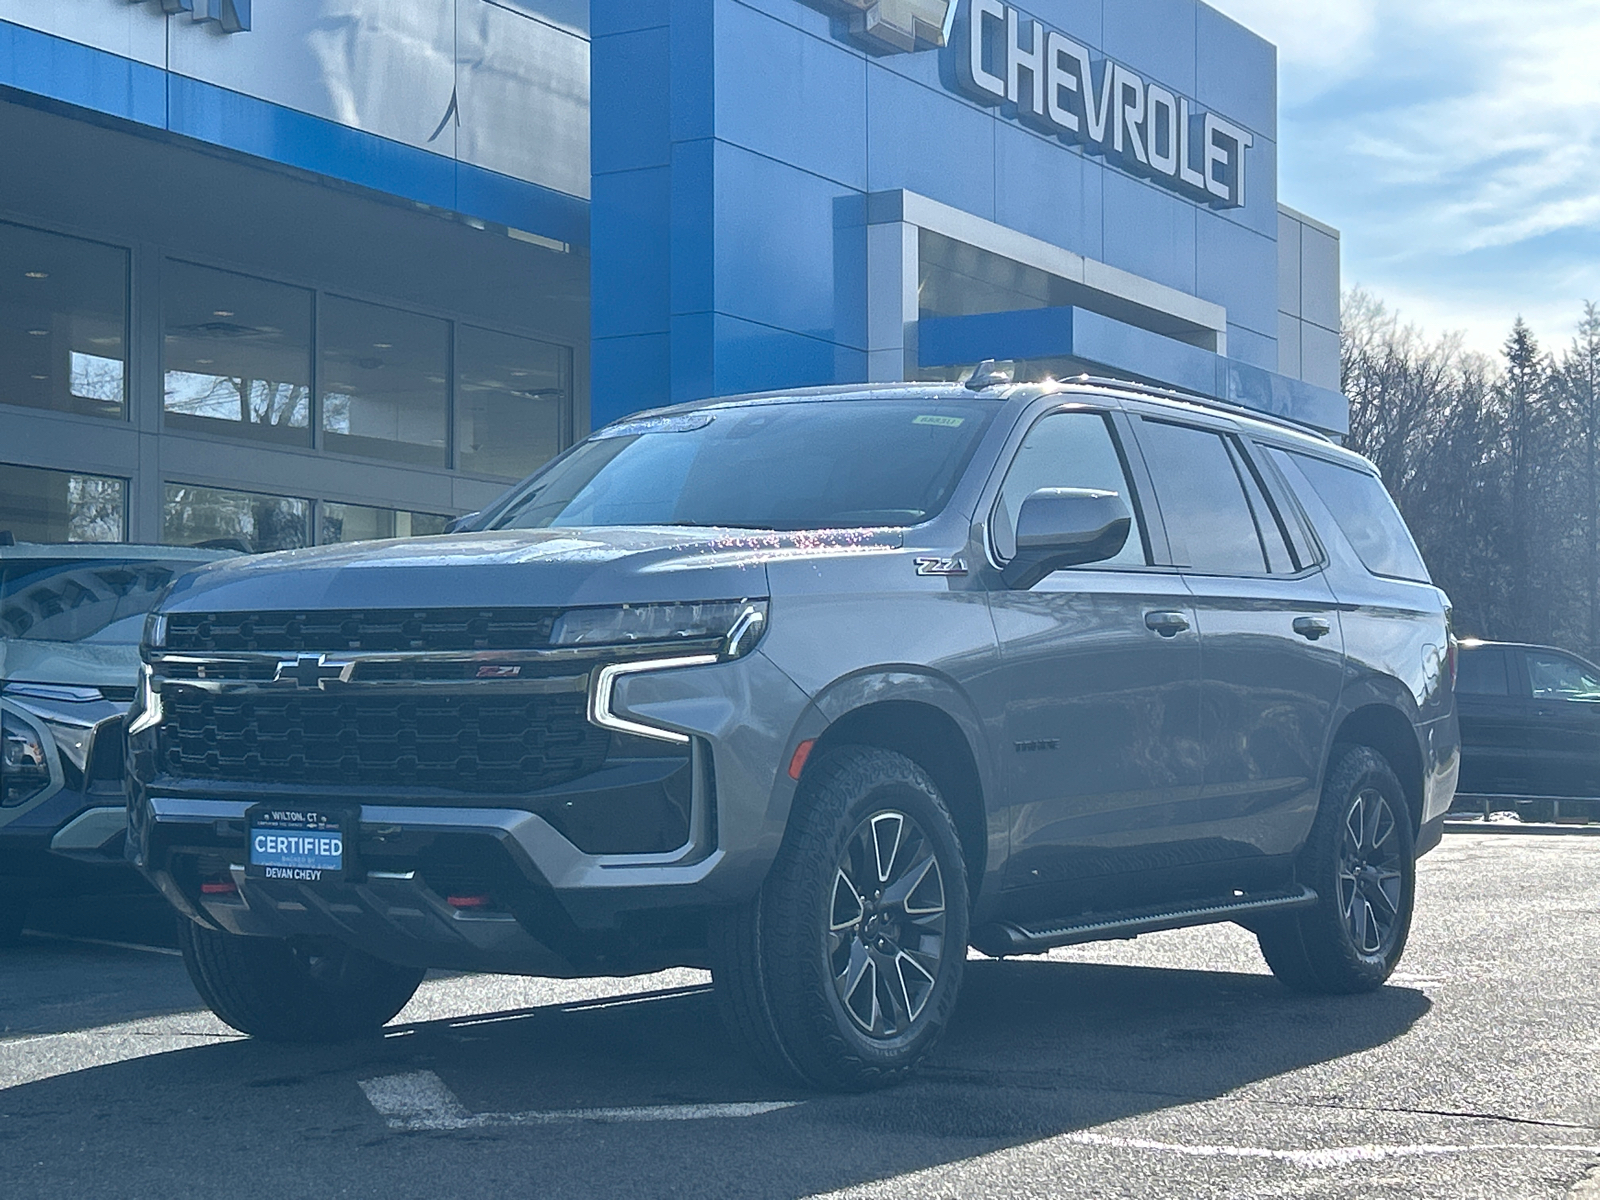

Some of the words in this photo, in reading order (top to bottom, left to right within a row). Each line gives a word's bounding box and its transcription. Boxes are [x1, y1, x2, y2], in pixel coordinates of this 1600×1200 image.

[970, 0, 1253, 208] CHEVROLET
[914, 557, 968, 576] Z71
[476, 665, 521, 677] Z71
[307, 813, 317, 822] CT
[255, 836, 343, 856] CERTIFIED
[266, 867, 293, 879] DEVAN
[294, 868, 322, 881] CHEVY
